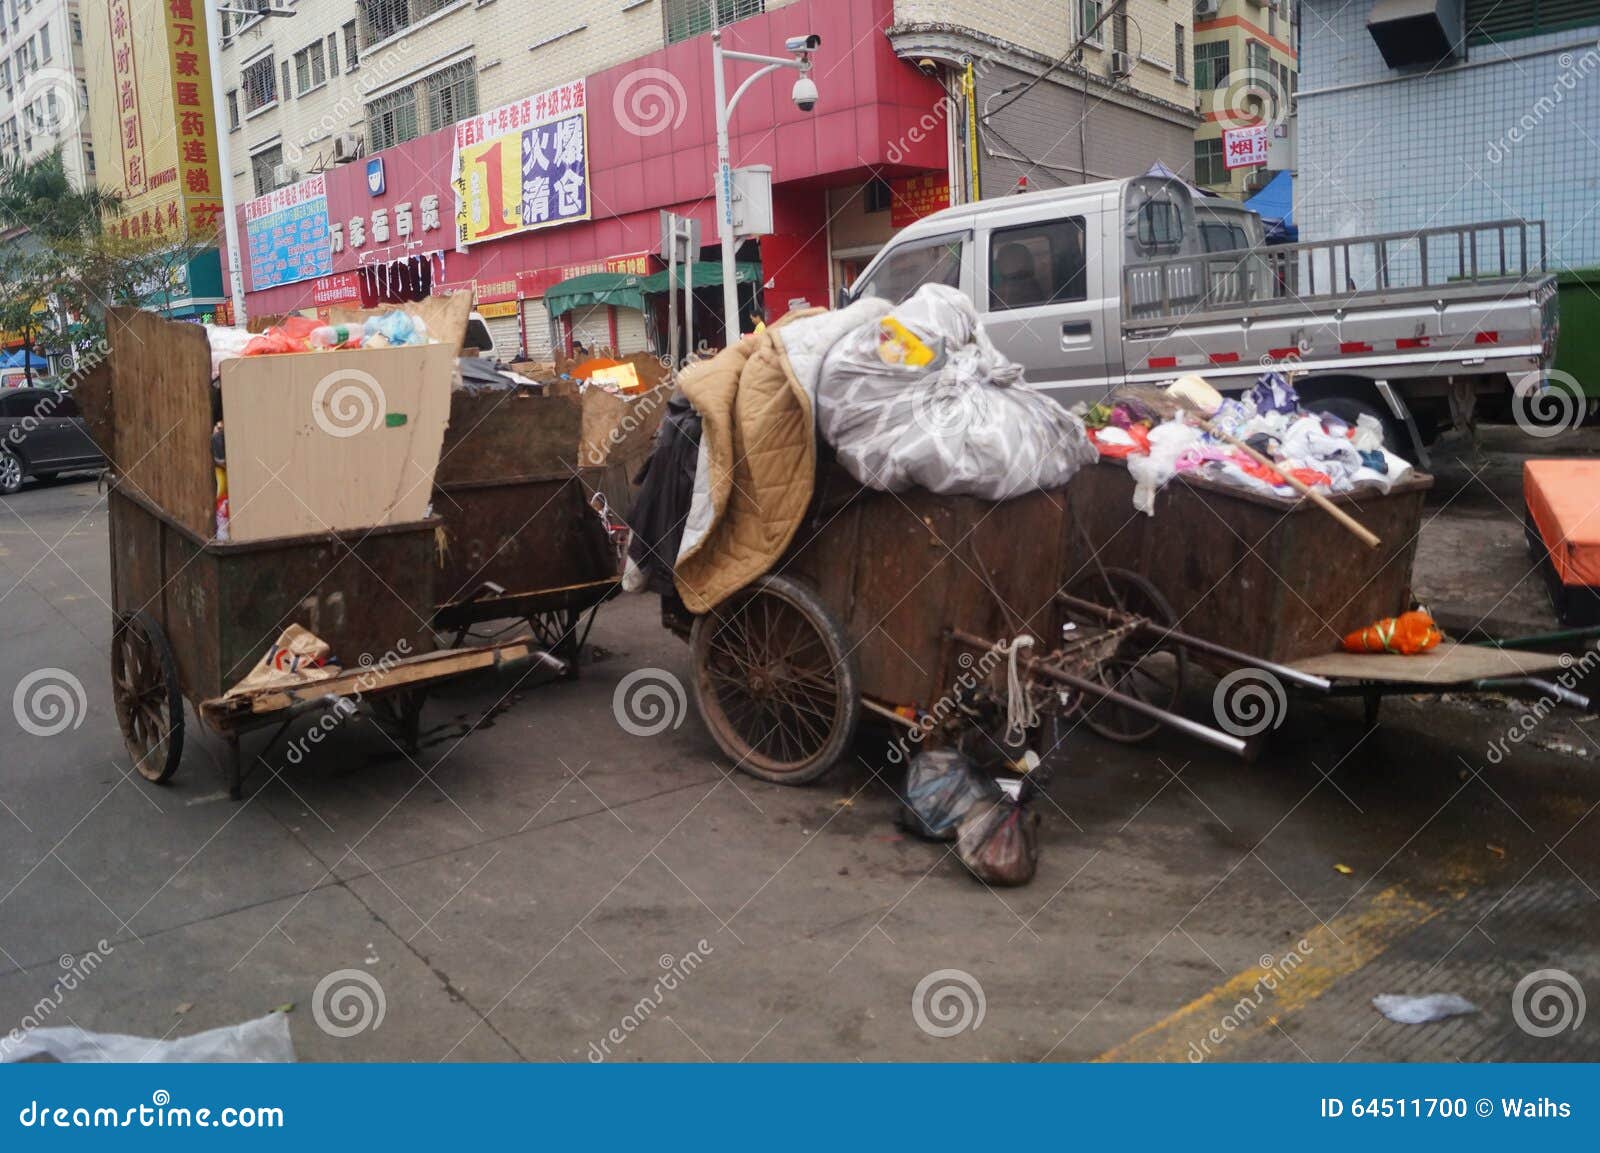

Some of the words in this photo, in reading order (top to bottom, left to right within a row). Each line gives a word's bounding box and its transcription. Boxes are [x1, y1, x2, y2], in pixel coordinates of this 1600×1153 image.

[488, 100, 531, 137] 十年老店
[536, 81, 584, 121] 升级改造
[523, 116, 583, 175] 火爆
[475, 141, 518, 238] 1
[522, 168, 584, 224] 清仓
[328, 195, 440, 254] 万家福百货
